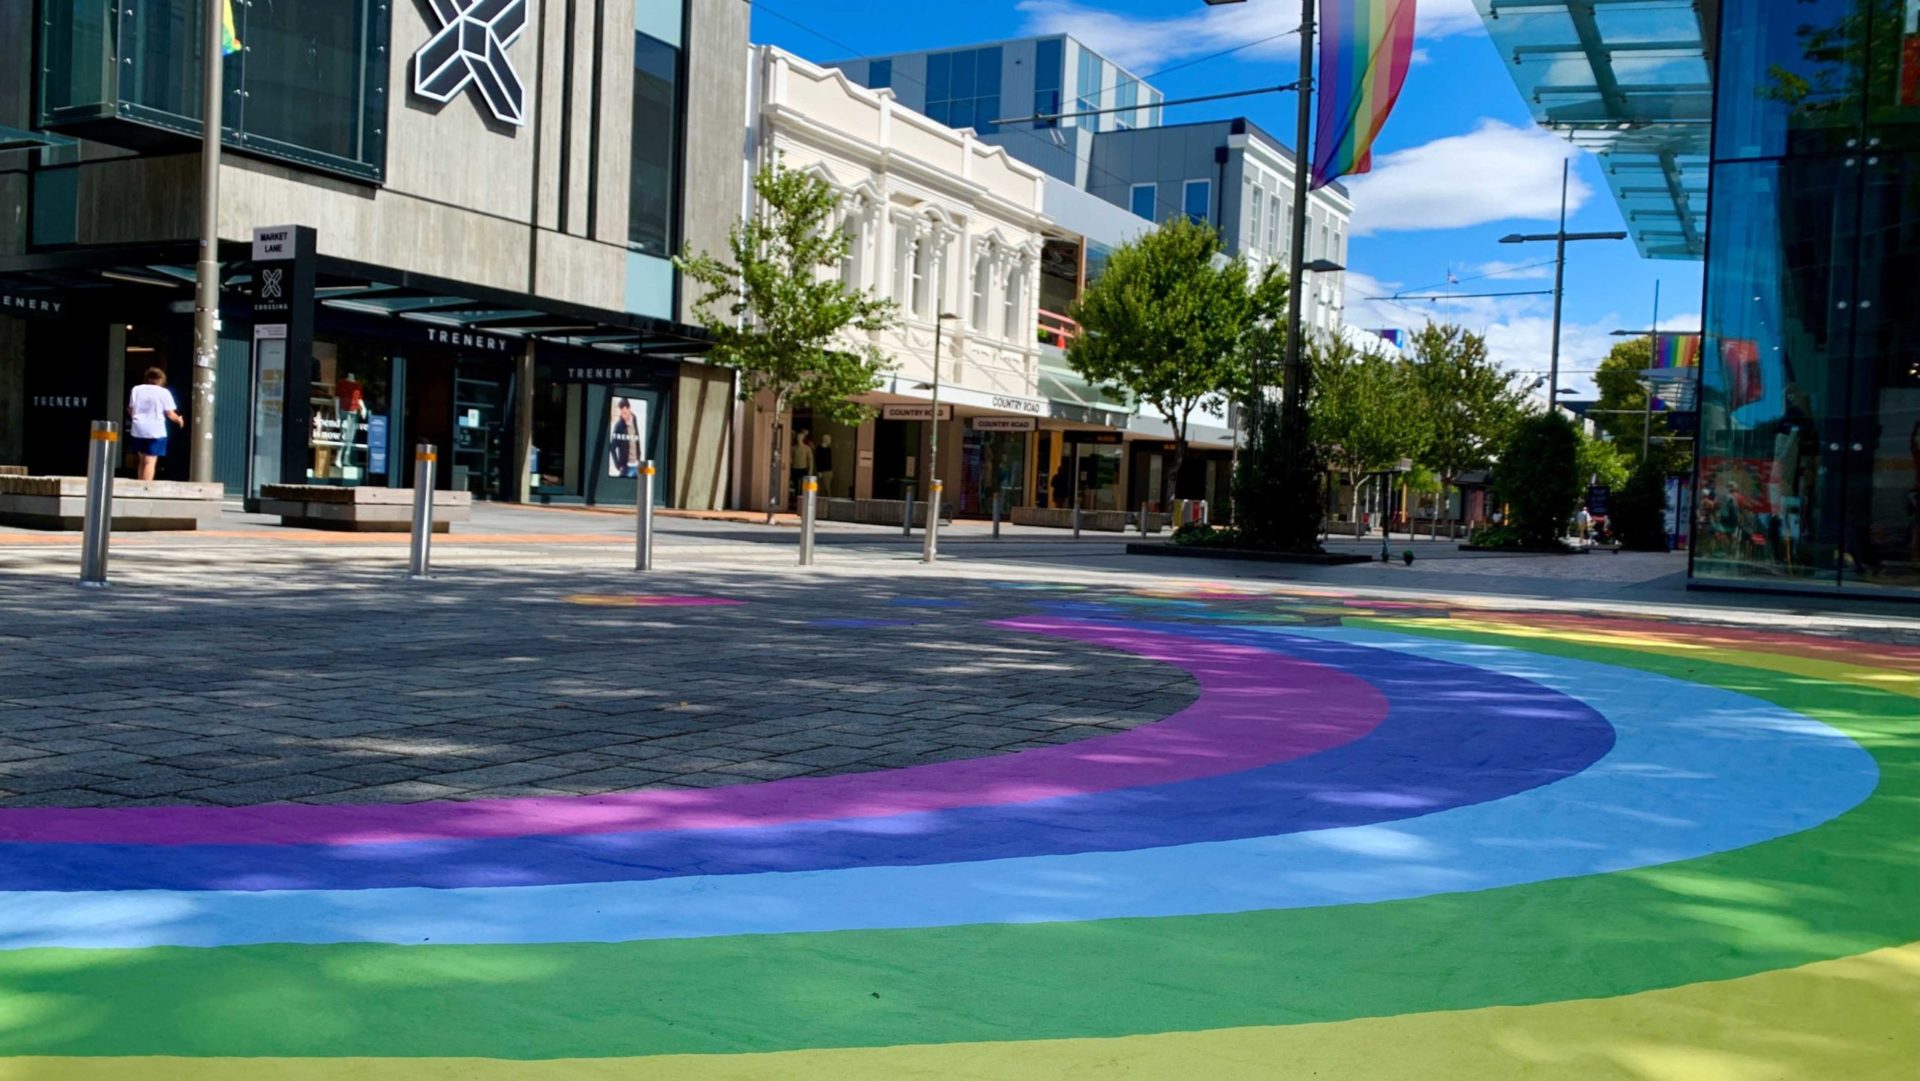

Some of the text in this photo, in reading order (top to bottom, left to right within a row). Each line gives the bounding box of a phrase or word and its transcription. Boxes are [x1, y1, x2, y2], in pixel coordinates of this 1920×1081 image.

[260, 231, 288, 241] MARKET
[264, 244, 283, 253] LANE
[427, 328, 507, 351] TRENERY
[568, 367, 632, 379] TRENERY
[33, 396, 88, 407] TRENERY
[992, 396, 1040, 414] COUNTRY ROAD
[889, 408, 944, 417] COUNTRY ROD
[978, 420, 1030, 429] COUNTRY ROAD
